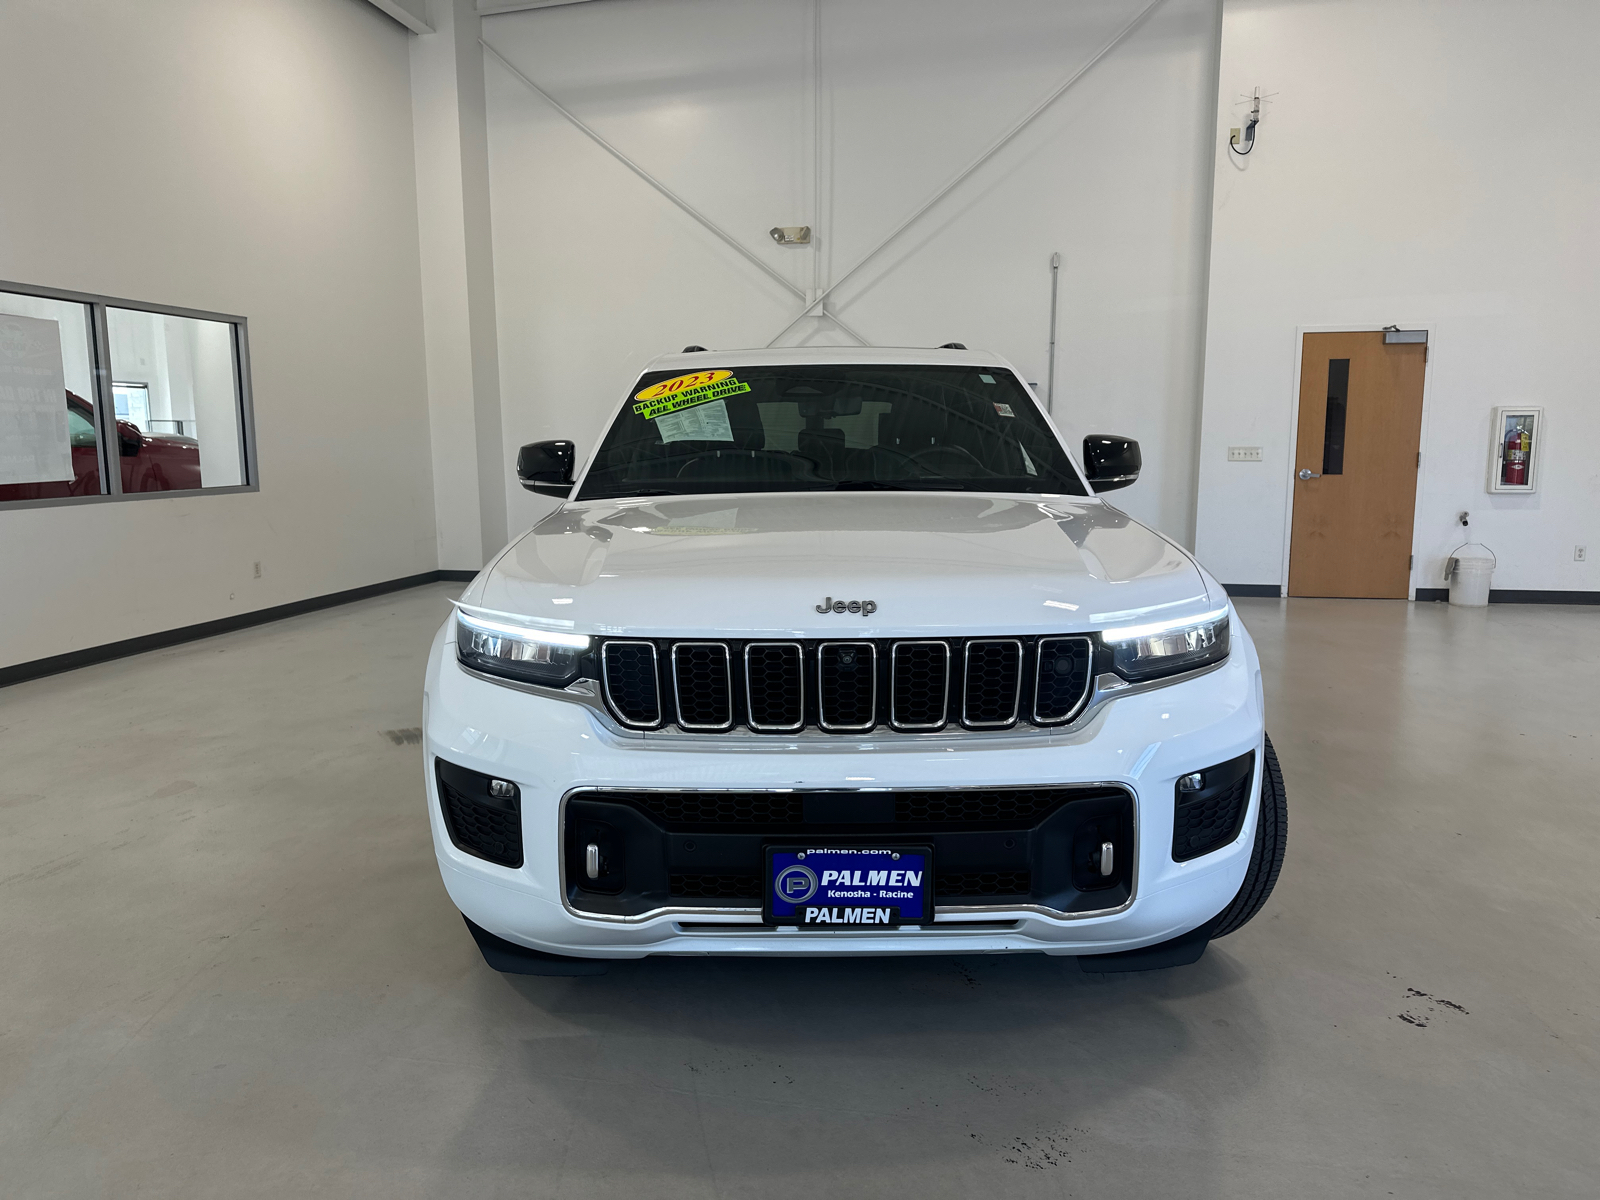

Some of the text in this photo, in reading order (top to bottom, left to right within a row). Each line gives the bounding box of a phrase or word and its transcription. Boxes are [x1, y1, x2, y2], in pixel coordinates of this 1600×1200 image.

[652, 372, 715, 397] 2023
[634, 379, 737, 413] BACKUP WARNING
[648, 385, 746, 417] ALL WHEEL DRIVE
[816, 597, 877, 617] Jeep
[821, 870, 923, 886] PALMEN
[827, 889, 871, 898] Kenosha
[879, 890, 914, 898] Racine
[804, 907, 891, 924] PALMEN
